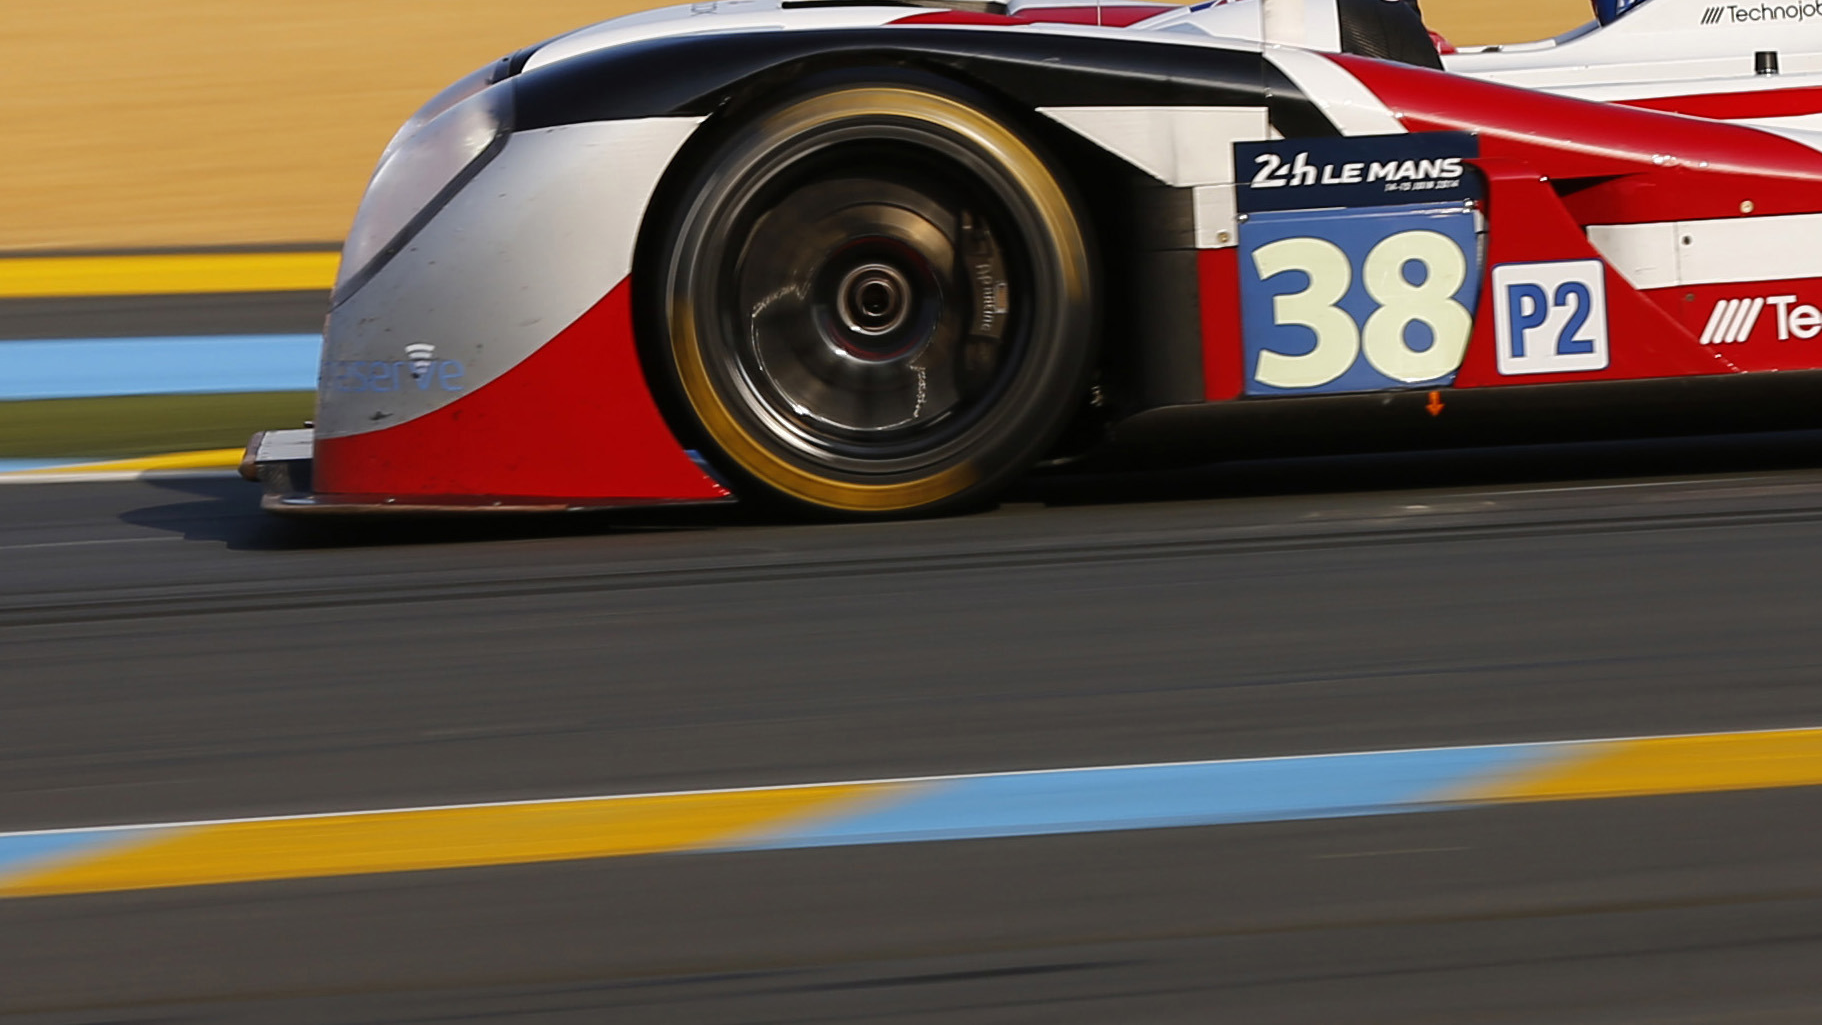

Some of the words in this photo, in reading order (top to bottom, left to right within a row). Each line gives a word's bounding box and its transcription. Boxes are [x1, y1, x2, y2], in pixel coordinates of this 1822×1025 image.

[1321, 163, 1365, 184] LE
[1366, 158, 1463, 182] MANS
[1251, 230, 1474, 388] 38
[1507, 280, 1595, 358] P2
